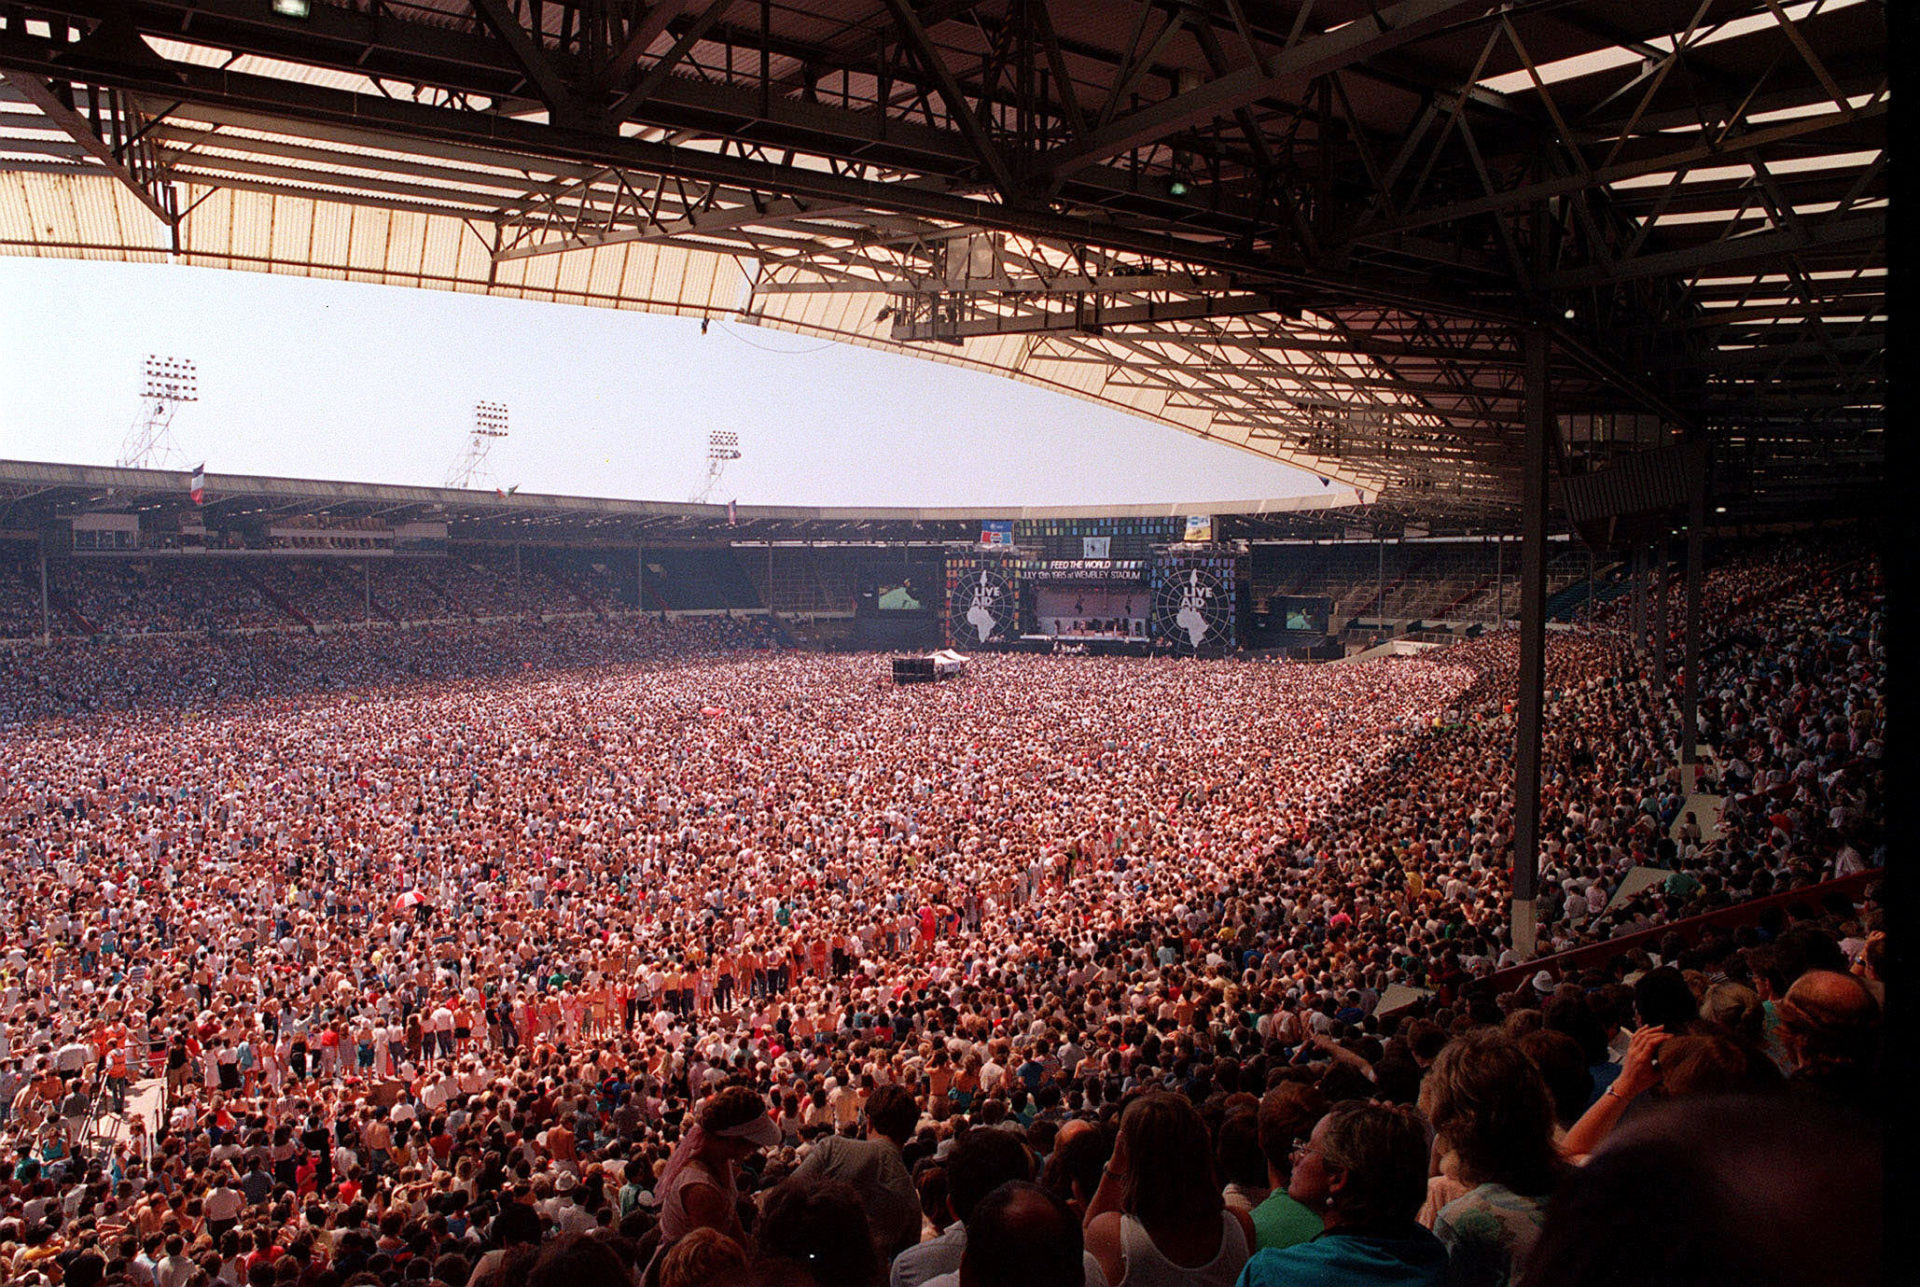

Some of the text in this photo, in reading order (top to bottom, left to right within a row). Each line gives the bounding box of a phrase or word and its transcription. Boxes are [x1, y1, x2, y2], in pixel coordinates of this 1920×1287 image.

[1050, 560, 1111, 569] FEED THE WORLD
[1022, 571, 1037, 579] JULY
[1074, 571, 1109, 580] WEMBLEY
[1111, 571, 1140, 580] STADIUM
[975, 587, 1000, 597] LIVE
[1184, 587, 1213, 598] LIVE
[972, 596, 993, 607] AID
[1181, 597, 1206, 608] AID
